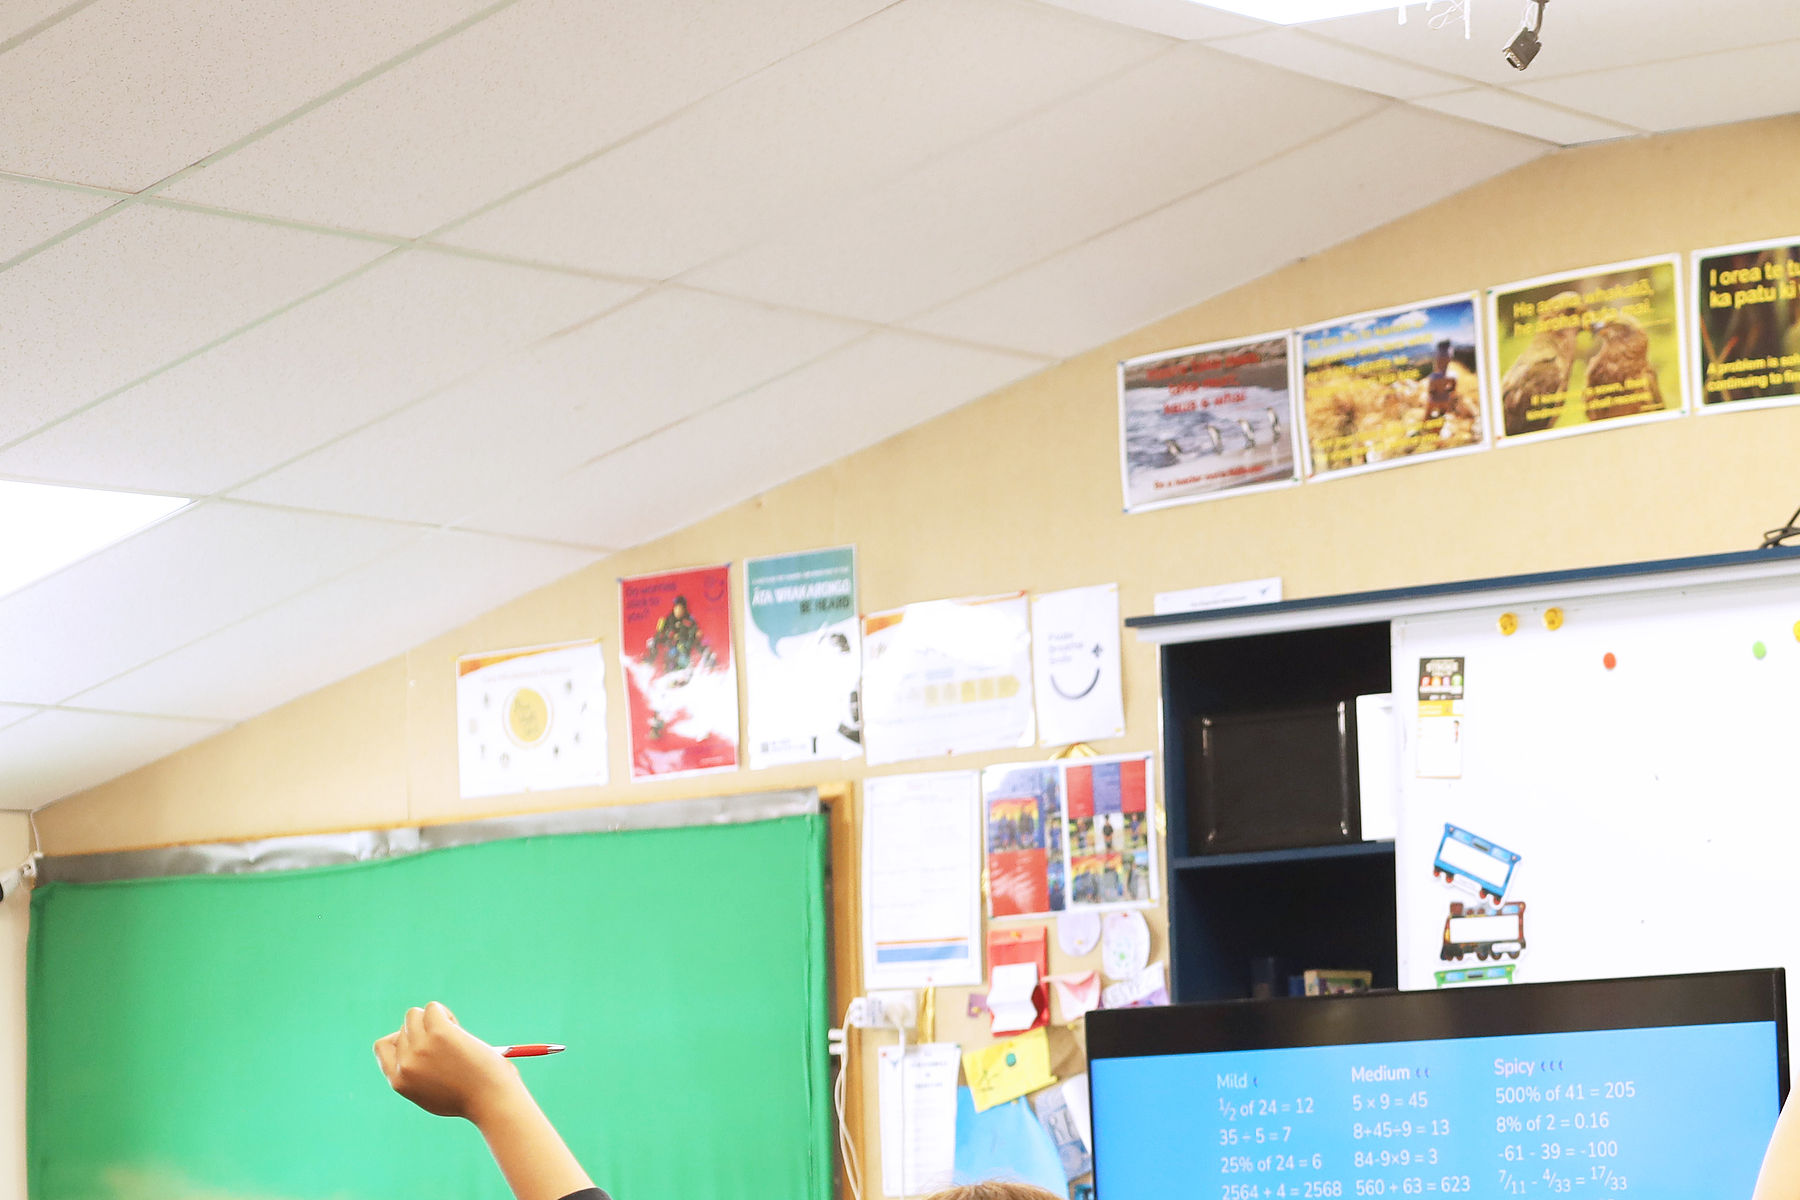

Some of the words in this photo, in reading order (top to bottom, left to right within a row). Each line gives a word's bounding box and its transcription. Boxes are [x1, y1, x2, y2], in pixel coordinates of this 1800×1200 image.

[1351, 1065, 1410, 1083] Medium
[1494, 1058, 1535, 1078] Spicy
[1217, 1072, 1248, 1088] Mild
[1352, 1094, 1362, 1111] 5
[1380, 1093, 1390, 1110] 9
[1408, 1091, 1428, 1108] 45
[1496, 1086, 1541, 1104] 500%
[1545, 1085, 1561, 1102] of
[1565, 1084, 1584, 1100] 41
[1604, 1081, 1635, 1098] 205
[1240, 1100, 1255, 1116] of
[1259, 1099, 1277, 1115] 24
[1296, 1097, 1314, 1113] 12
[1432, 1119, 1450, 1136] 13
[1496, 1116, 1522, 1133] 8%
[1526, 1115, 1542, 1131] of
[1546, 1114, 1556, 1131] 2
[1575, 1112, 1609, 1129] 0.16
[1220, 1129, 1237, 1146] 35
[1255, 1128, 1265, 1143] 5
[1282, 1126, 1292, 1142] 7
[1428, 1148, 1438, 1164] 3
[1541, 1143, 1561, 1160] 39
[1221, 1156, 1253, 1173] 25%
[1257, 1156, 1272, 1172] of
[1276, 1155, 1294, 1171] 24
[1312, 1153, 1322, 1169] 6
[1222, 1184, 1258, 1200] 2564
[1276, 1184, 1286, 1198] 4
[1304, 1180, 1342, 1198] 2568
[1356, 1179, 1384, 1196] 560
[1403, 1177, 1422, 1194] 63
[1441, 1176, 1470, 1192] 623
